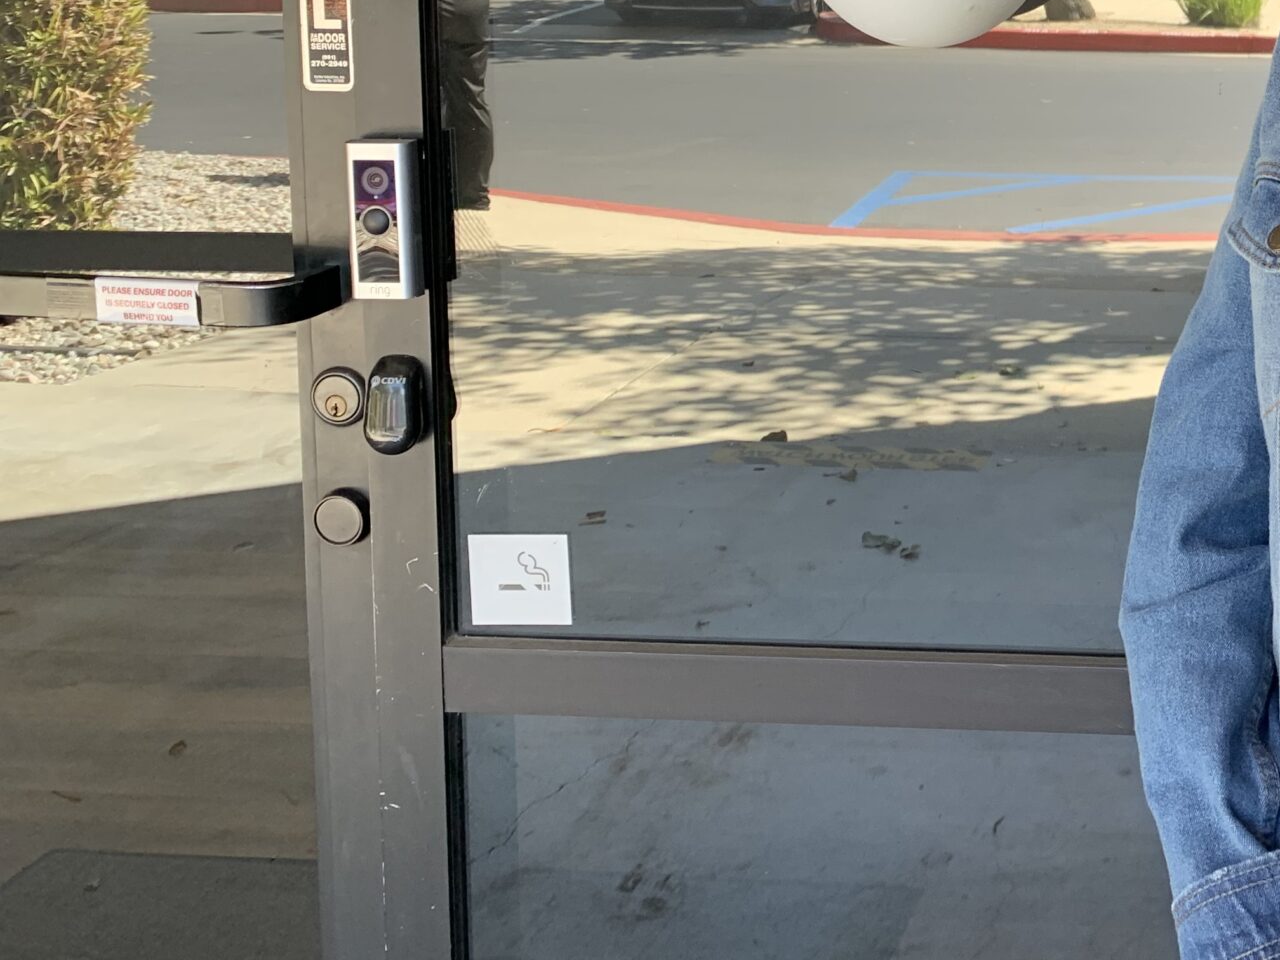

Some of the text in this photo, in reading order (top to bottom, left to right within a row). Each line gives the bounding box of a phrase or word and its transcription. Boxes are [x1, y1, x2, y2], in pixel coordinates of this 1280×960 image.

[318, 33, 345, 42] DOOR
[102, 286, 193, 297] PLEASE ENSURE DOOR
[370, 285, 391, 297] ring
[114, 300, 155, 309] SECURELY
[157, 302, 189, 310] CLOSED
[123, 312, 173, 322] BEHIND YOU
